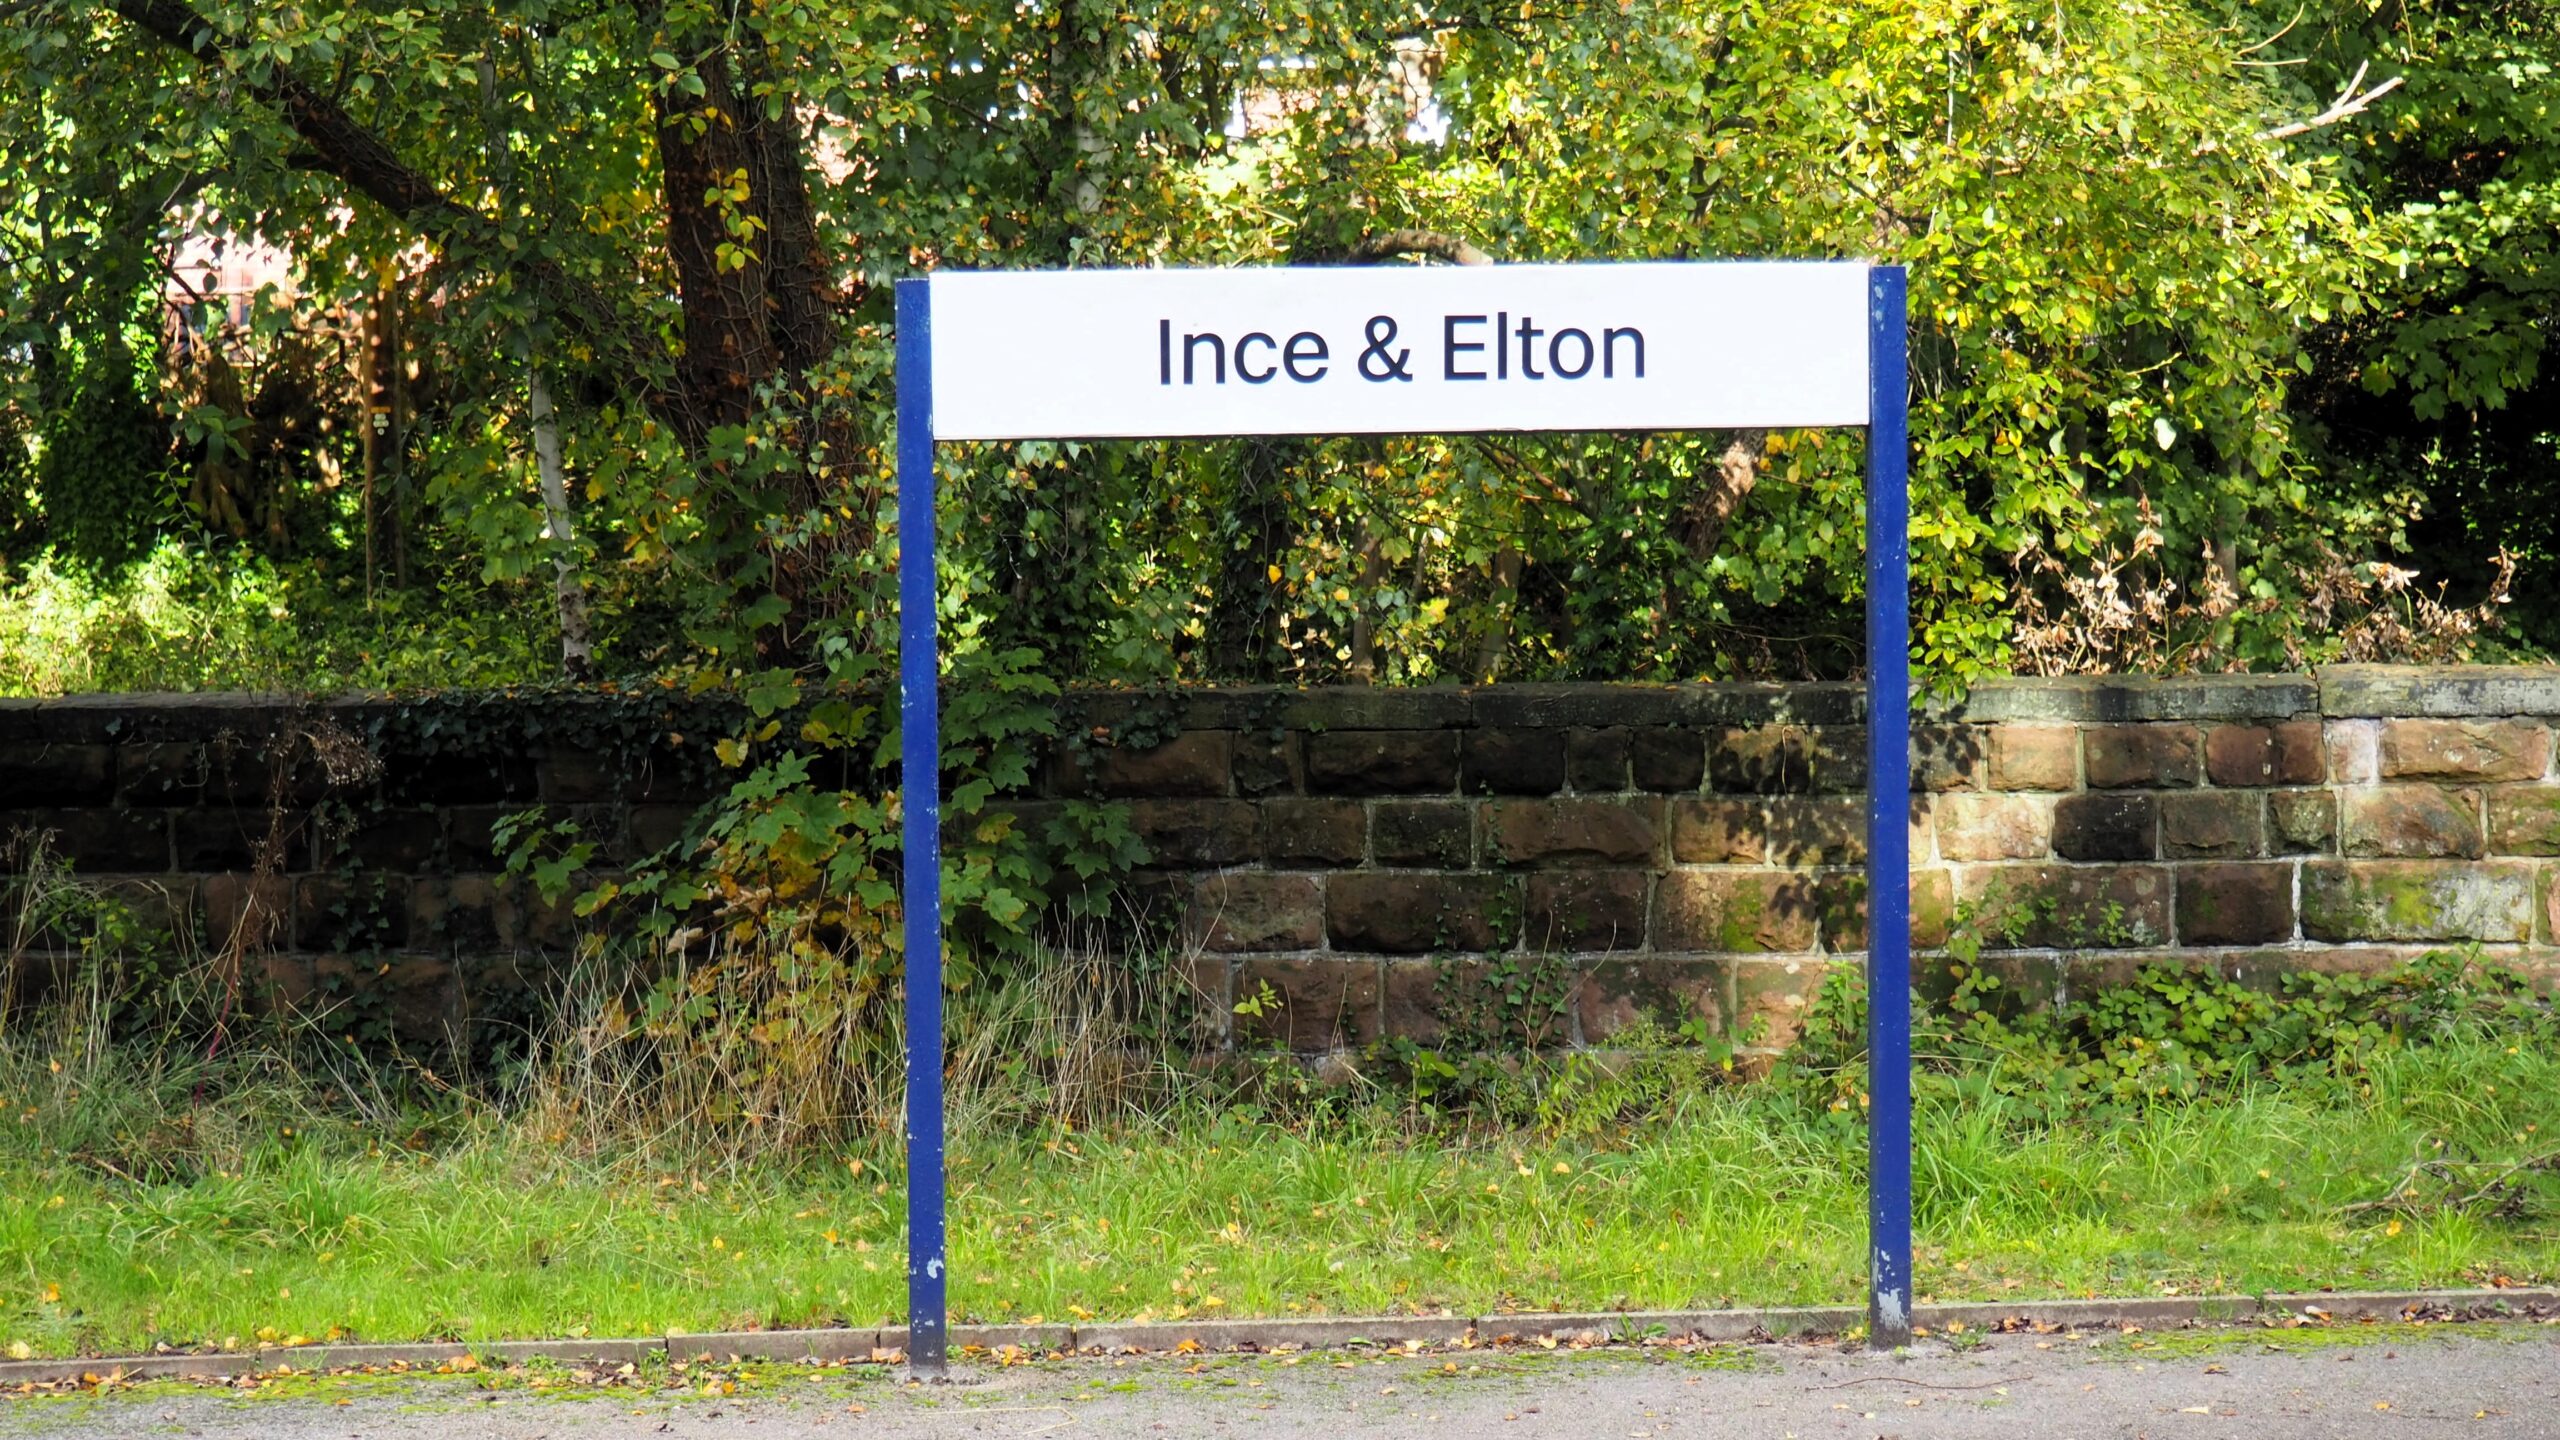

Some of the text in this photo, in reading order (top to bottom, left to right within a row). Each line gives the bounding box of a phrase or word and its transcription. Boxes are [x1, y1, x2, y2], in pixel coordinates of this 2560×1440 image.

[1160, 311, 1645, 385] Ince & Elton
